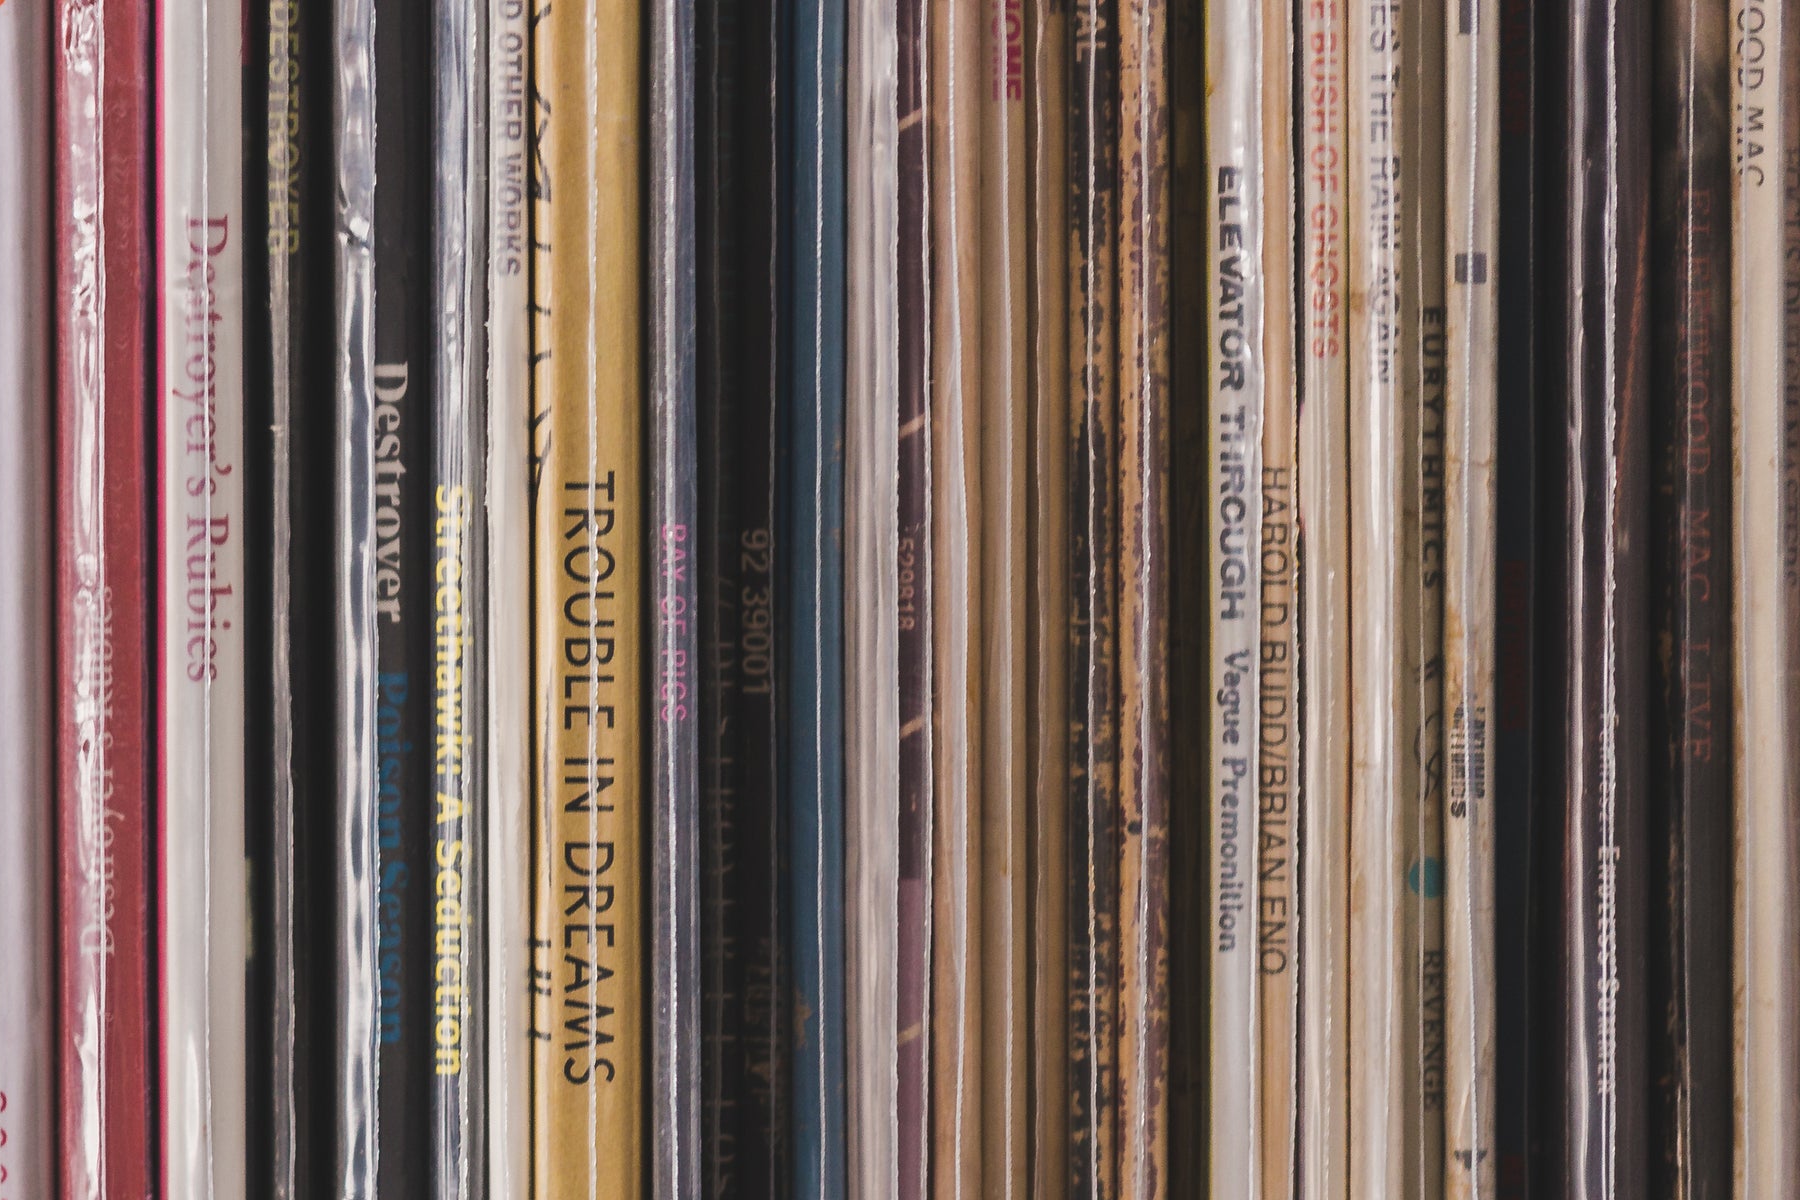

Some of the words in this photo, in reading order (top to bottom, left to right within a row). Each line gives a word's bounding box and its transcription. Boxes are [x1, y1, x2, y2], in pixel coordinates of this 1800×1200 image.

[496, 31, 522, 142] OTHER
[1309, 32, 1337, 134] BUSH
[1368, 65, 1400, 143] THE
[1737, 0, 1765, 92] OOD
[267, 0, 300, 257] DESTROYER
[1309, 143, 1337, 193] OF
[1735, 105, 1764, 190] MAC
[495, 155, 522, 279] WORKS
[1368, 156, 1400, 250] RAIN
[1216, 164, 1245, 389] ELEVATOR
[1309, 203, 1338, 360] GHOSTS
[1679, 188, 1710, 478] FLEETWOOD
[374, 360, 409, 621] Destroyer
[1421, 305, 1446, 591] EURYTHMICS
[660, 523, 686, 581] BAY
[740, 527, 769, 574] 92
[1217, 409, 1245, 622] THROUGH
[1259, 466, 1289, 625] HAROLD
[1681, 508, 1710, 603] MAC
[185, 513, 233, 684] Rubies
[434, 483, 471, 781] Streethawk:
[561, 470, 615, 734] TROUBLE
[660, 593, 685, 637] OF
[740, 585, 769, 698] 39001
[897, 536, 915, 631] 529818
[660, 649, 686, 723] PIGS
[1214, 648, 1249, 744] Vague
[1680, 637, 1711, 767] LIVE
[377, 671, 411, 850] Poison
[435, 791, 462, 825] A
[563, 757, 614, 814] IN
[1259, 638, 1288, 880] BUDD/BRIAN
[1216, 756, 1247, 953] Premonition
[378, 862, 410, 1046] Season
[434, 837, 468, 1077] Seduction
[562, 842, 615, 1087] DREAMS
[1258, 898, 1287, 977] ENO
[1420, 948, 1444, 1113] REVENGE
